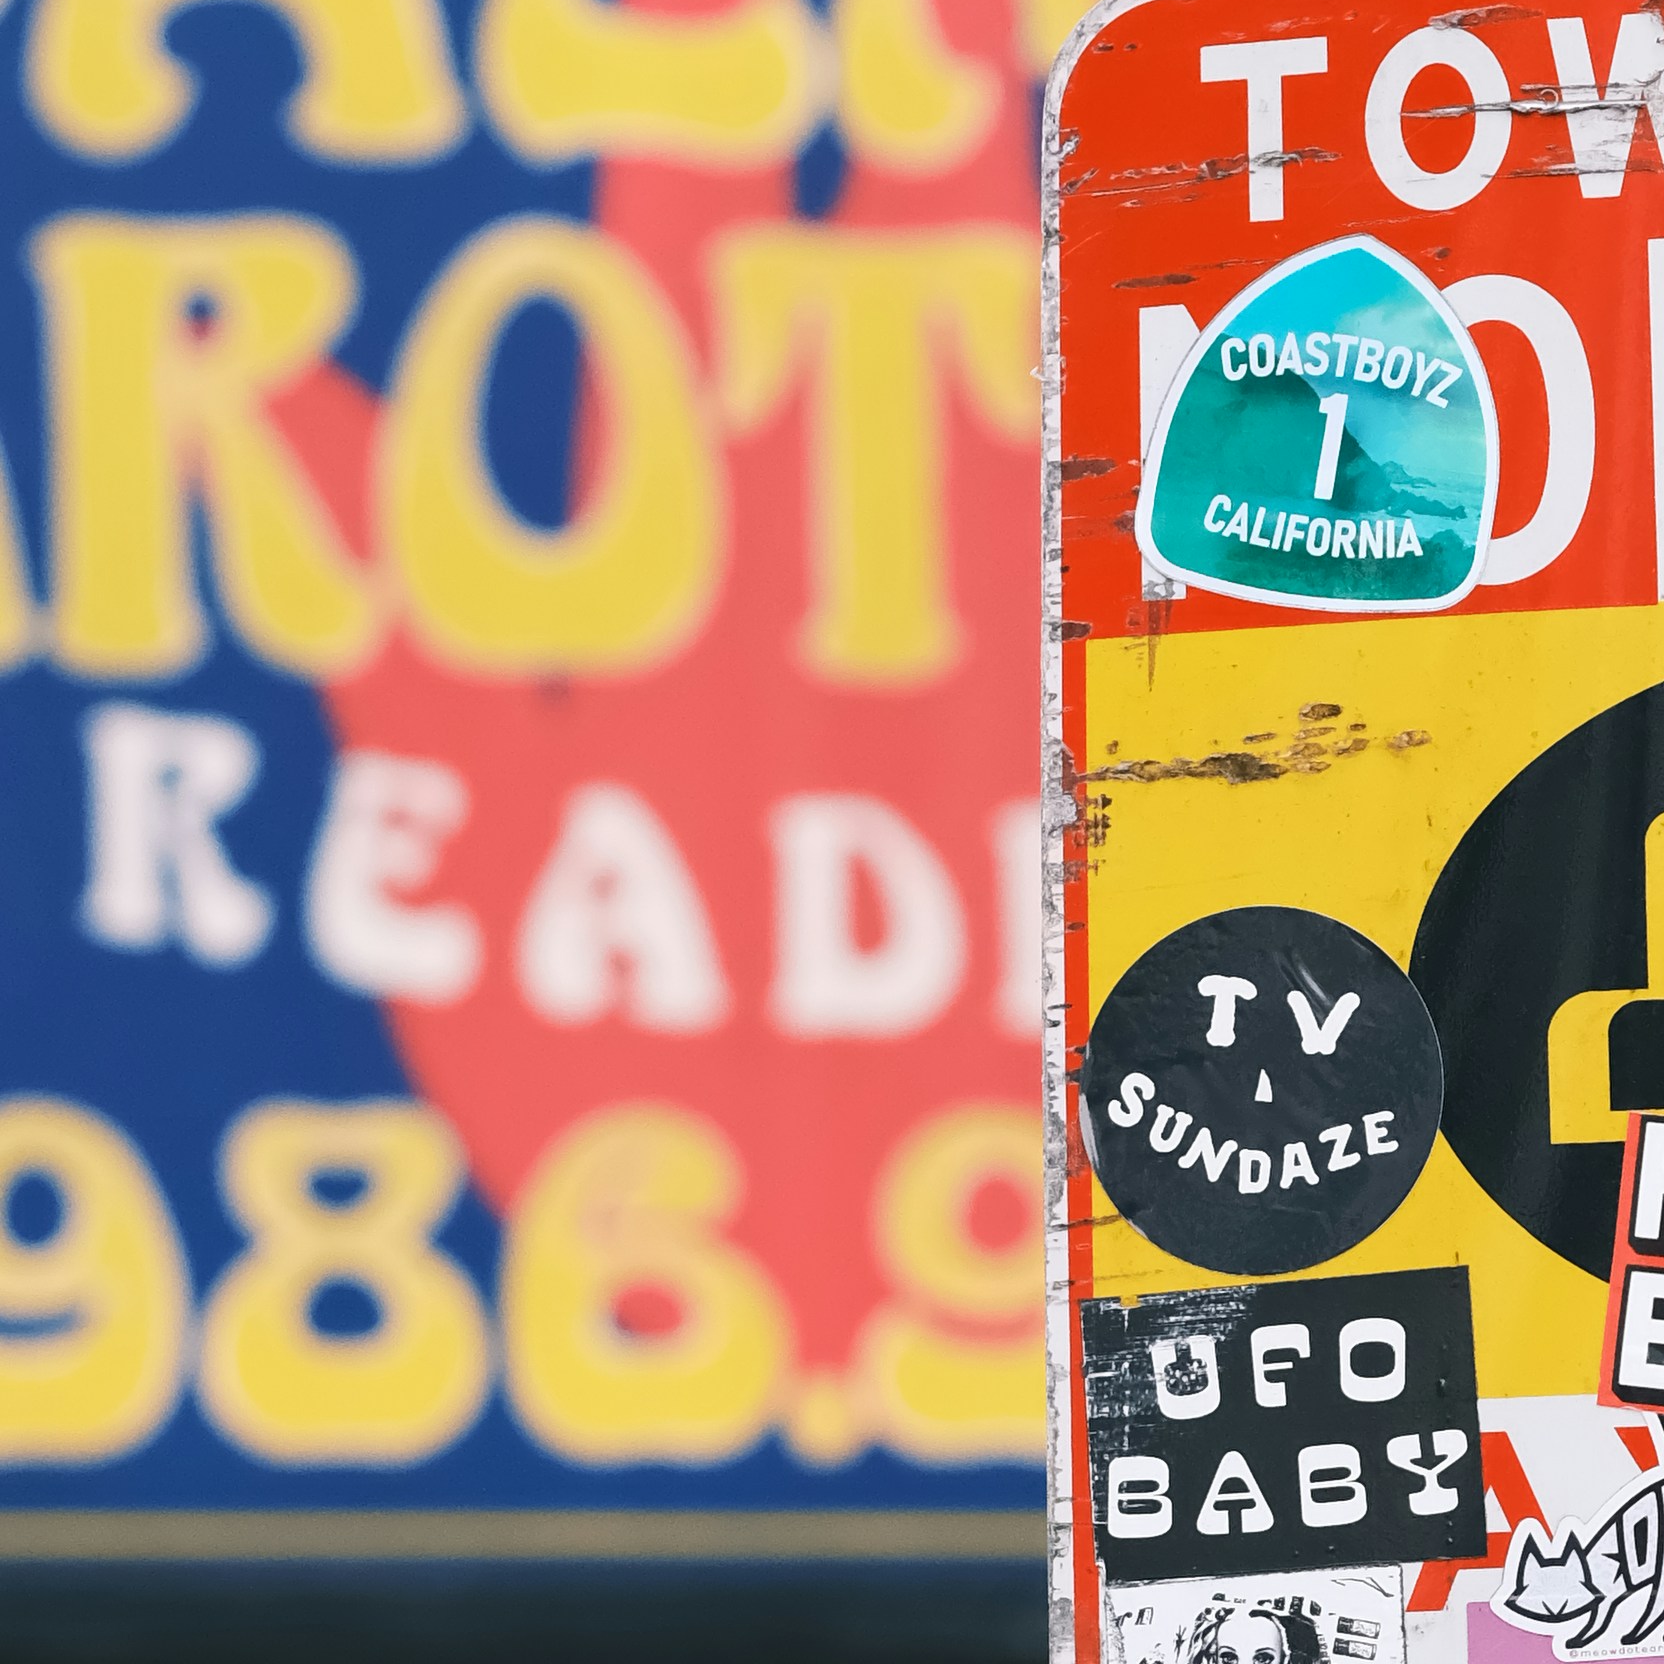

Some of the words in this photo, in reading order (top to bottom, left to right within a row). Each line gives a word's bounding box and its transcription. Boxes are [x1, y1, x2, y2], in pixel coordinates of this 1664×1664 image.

[1220, 331, 1464, 409] COASTBOYZ
[1313, 392, 1349, 501] 1
[1203, 493, 1424, 560] CALIFORNIA
[1107, 1072, 1399, 1194] SUNDAZE
[1149, 1317, 1407, 1420] UFO
[1106, 1428, 1469, 1539] BABY
